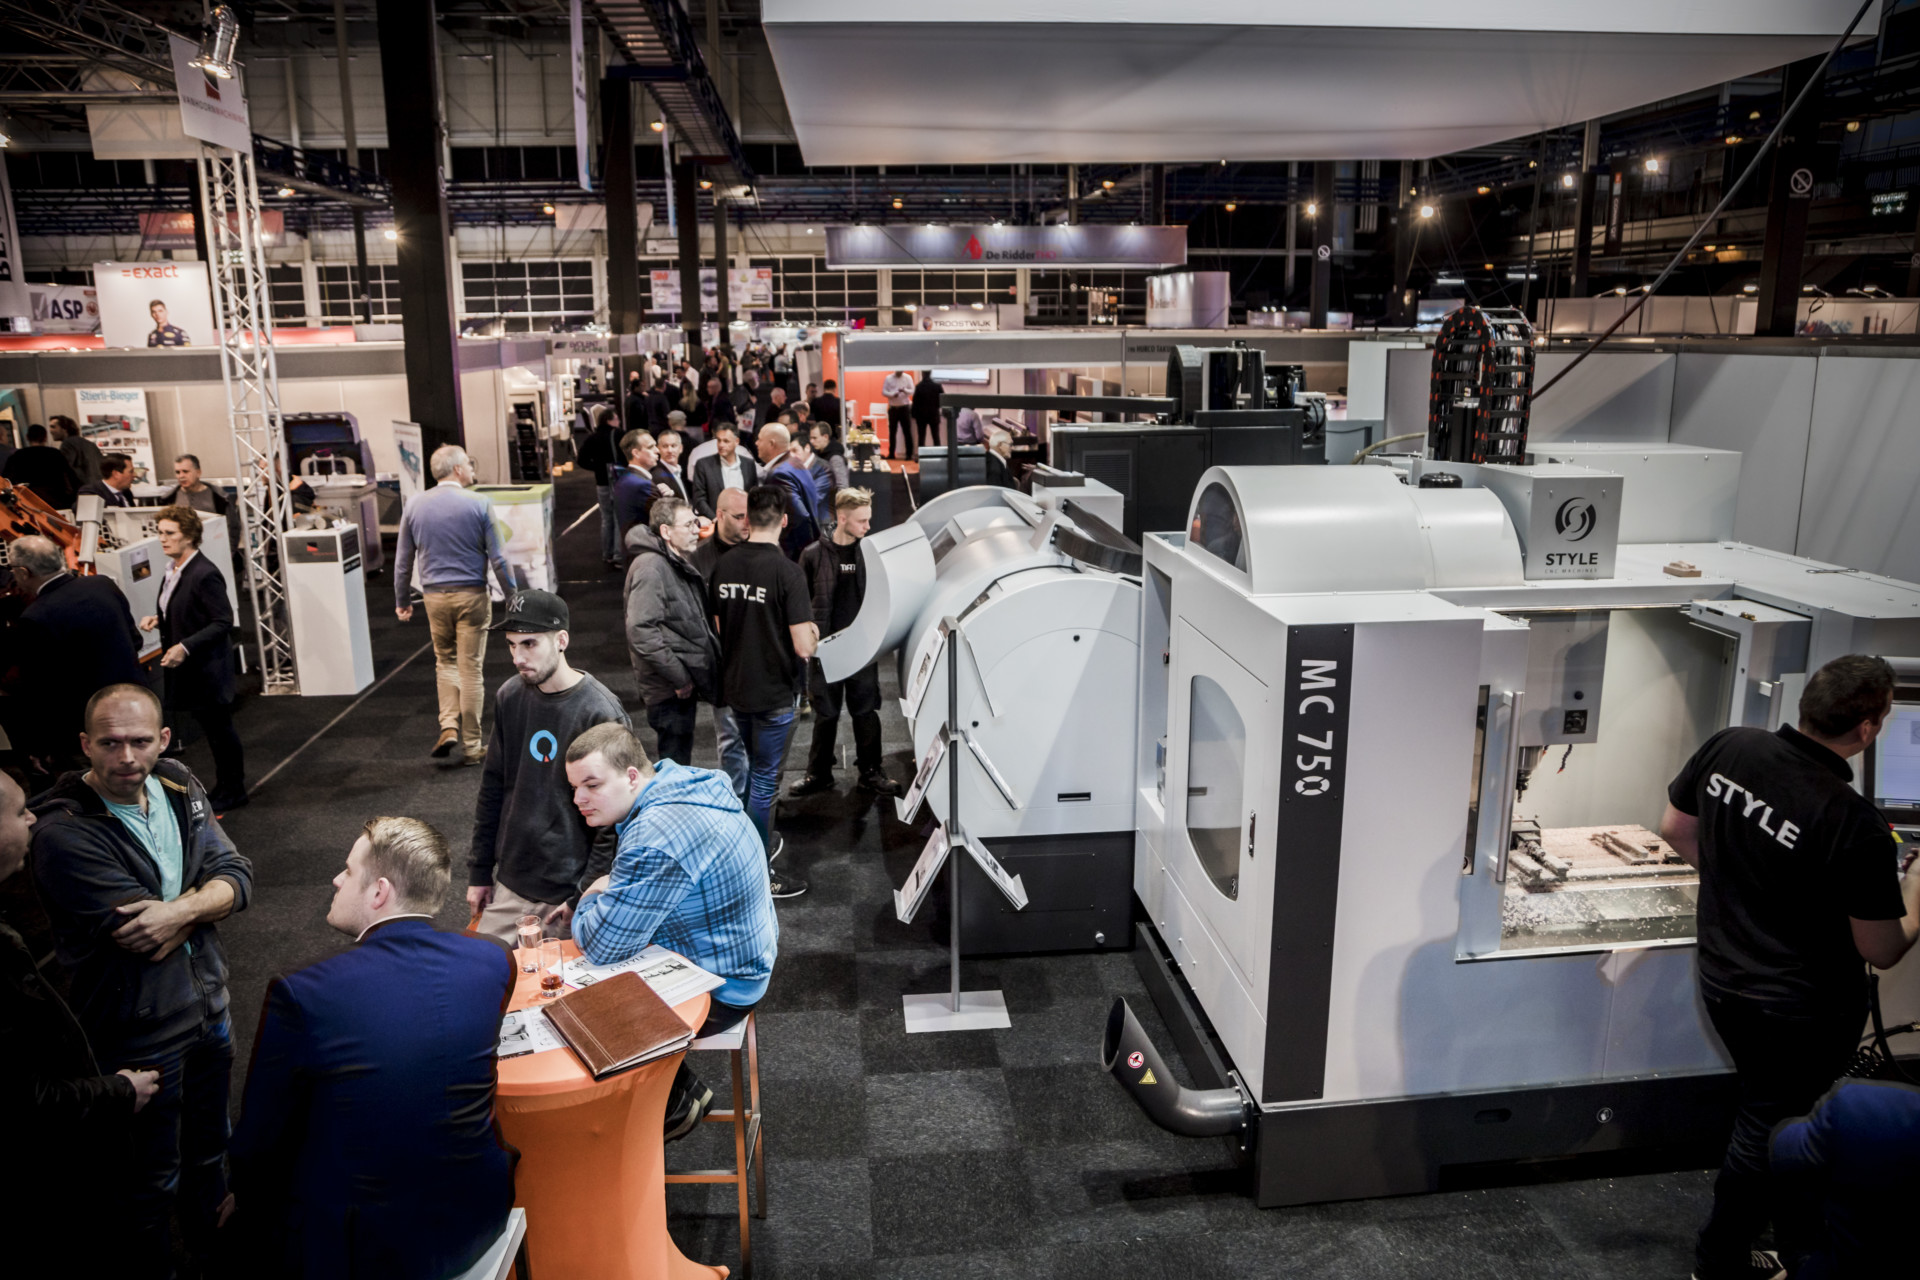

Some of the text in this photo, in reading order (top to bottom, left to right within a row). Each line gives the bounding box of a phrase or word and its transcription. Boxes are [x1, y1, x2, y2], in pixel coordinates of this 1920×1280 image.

[986, 250, 1000, 260] De
[51, 299, 83, 320] ASP
[934, 319, 991, 328] TROOSTWIJK
[1545, 552, 1599, 566] STYLE
[1294, 659, 1338, 796] MC 750
[1705, 772, 1801, 850] STYLE
